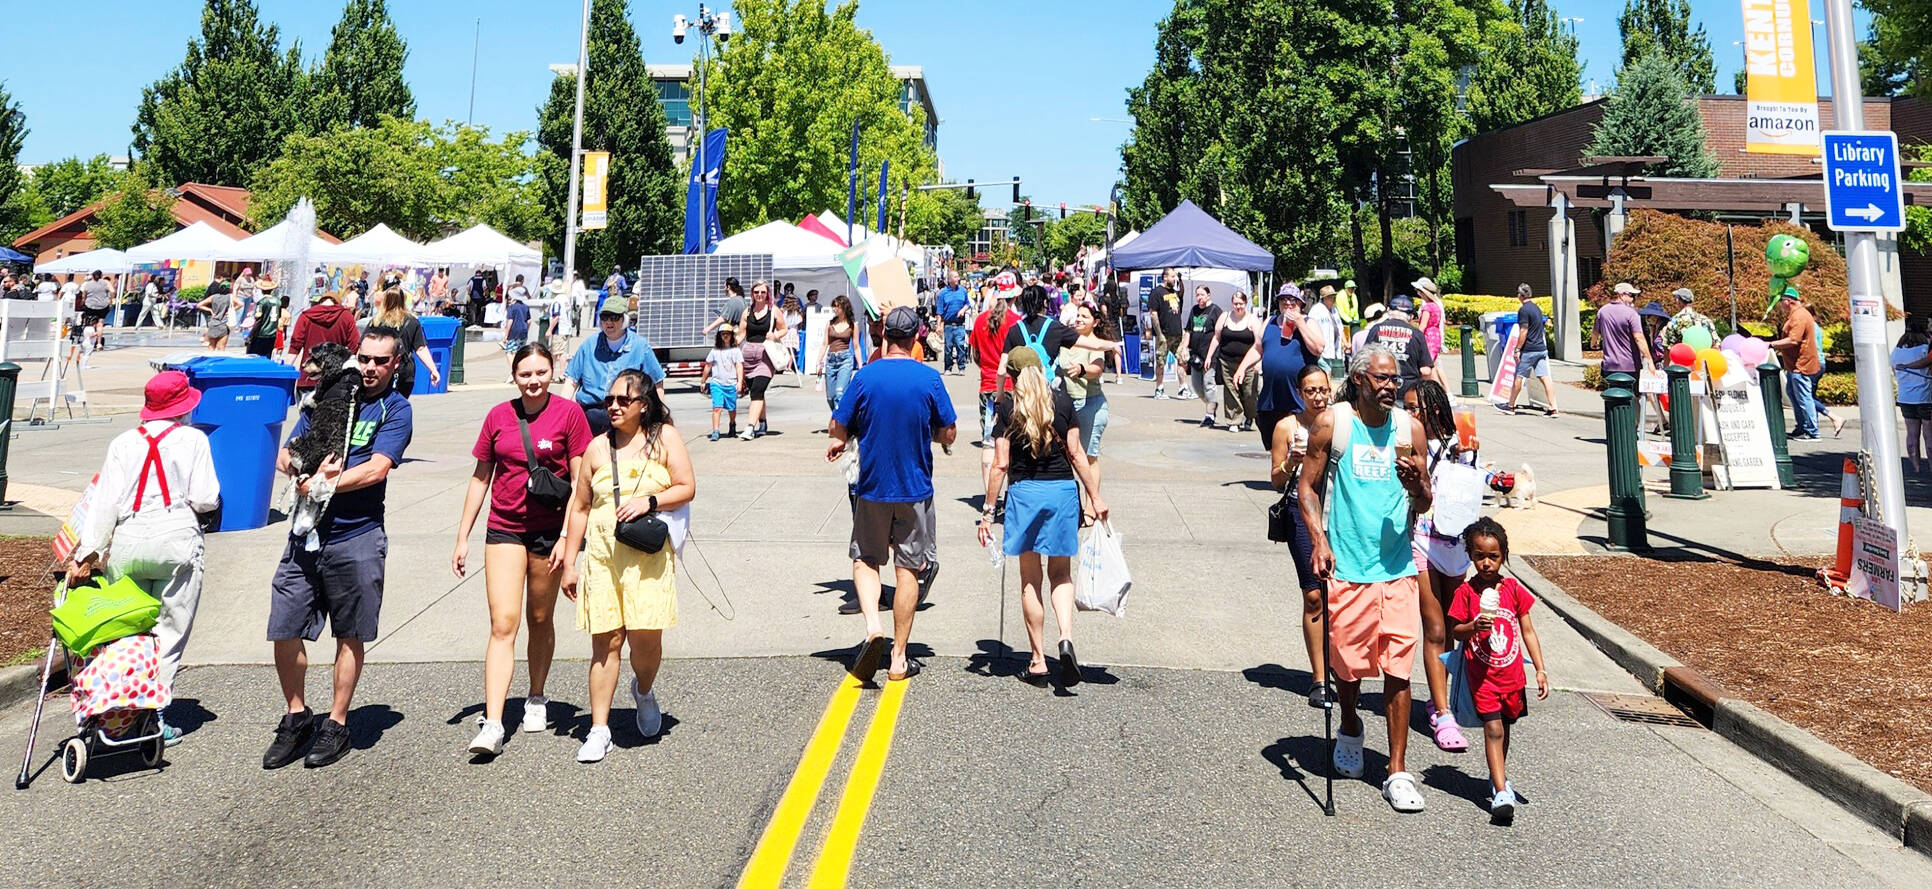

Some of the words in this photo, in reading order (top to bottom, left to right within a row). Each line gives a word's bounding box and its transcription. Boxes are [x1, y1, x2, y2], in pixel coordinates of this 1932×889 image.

[1774, 0, 1796, 77] CORNU
[1756, 103, 1779, 113] Brought
[1780, 104, 1787, 113] To
[1788, 105, 1799, 113] You
[1800, 106, 1808, 114] By
[1749, 116, 1814, 131] amazon
[1833, 142, 1885, 166] Library
[1835, 168, 1890, 193] Parking
[1353, 464, 1390, 479] REEF
[1857, 558, 1895, 583] FARMERS
